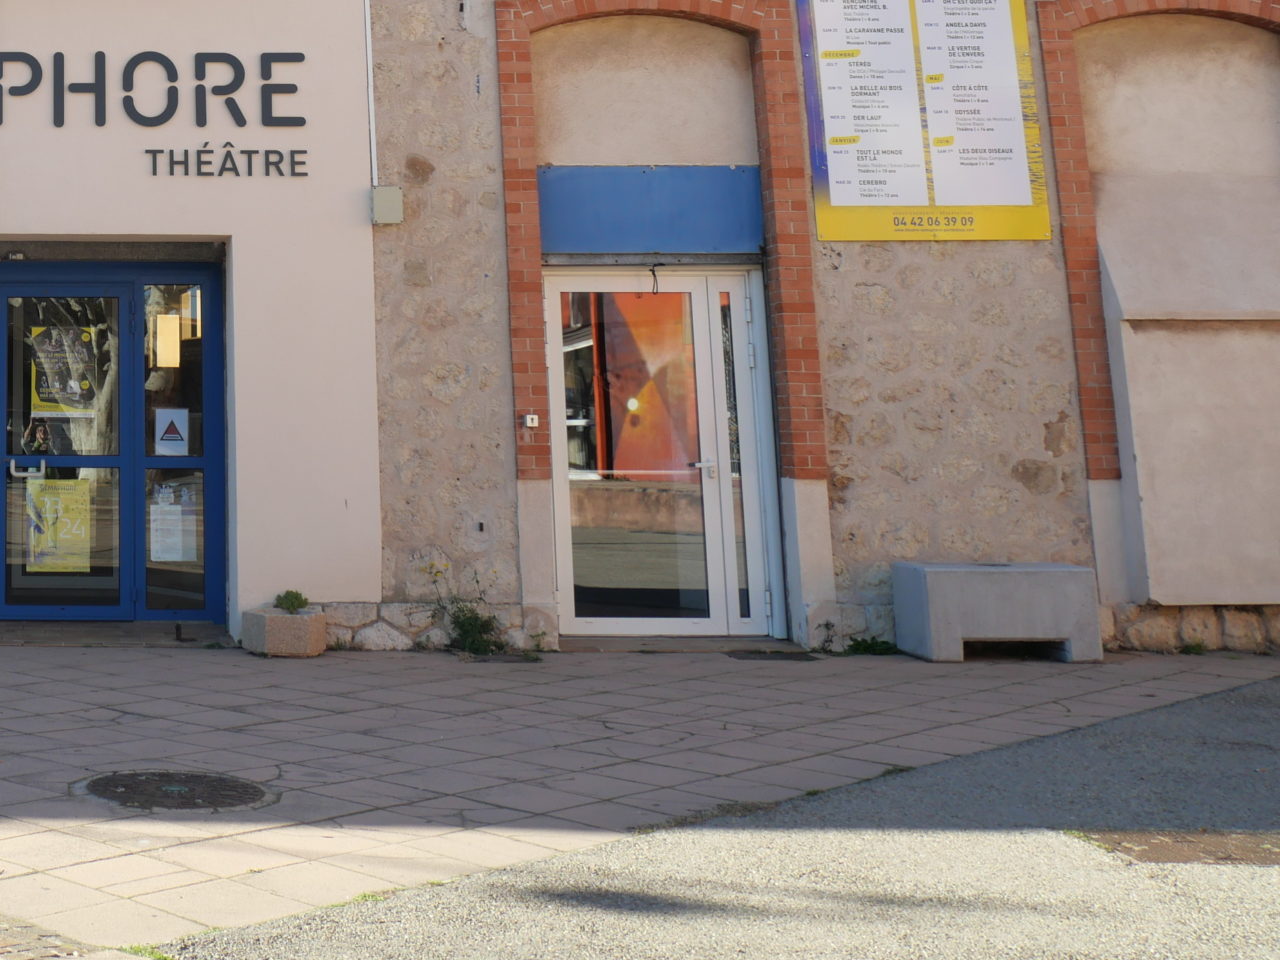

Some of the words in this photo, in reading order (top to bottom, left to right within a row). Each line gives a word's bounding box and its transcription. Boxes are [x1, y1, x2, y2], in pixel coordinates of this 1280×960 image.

[145, 141, 309, 177] THÉÂTRE
[893, 216, 907, 226] 04
[910, 216, 924, 226] 42
[927, 216, 941, 226] 06
[944, 216, 957, 226] 39
[961, 216, 974, 226] 09
[59, 517, 86, 538] 24
